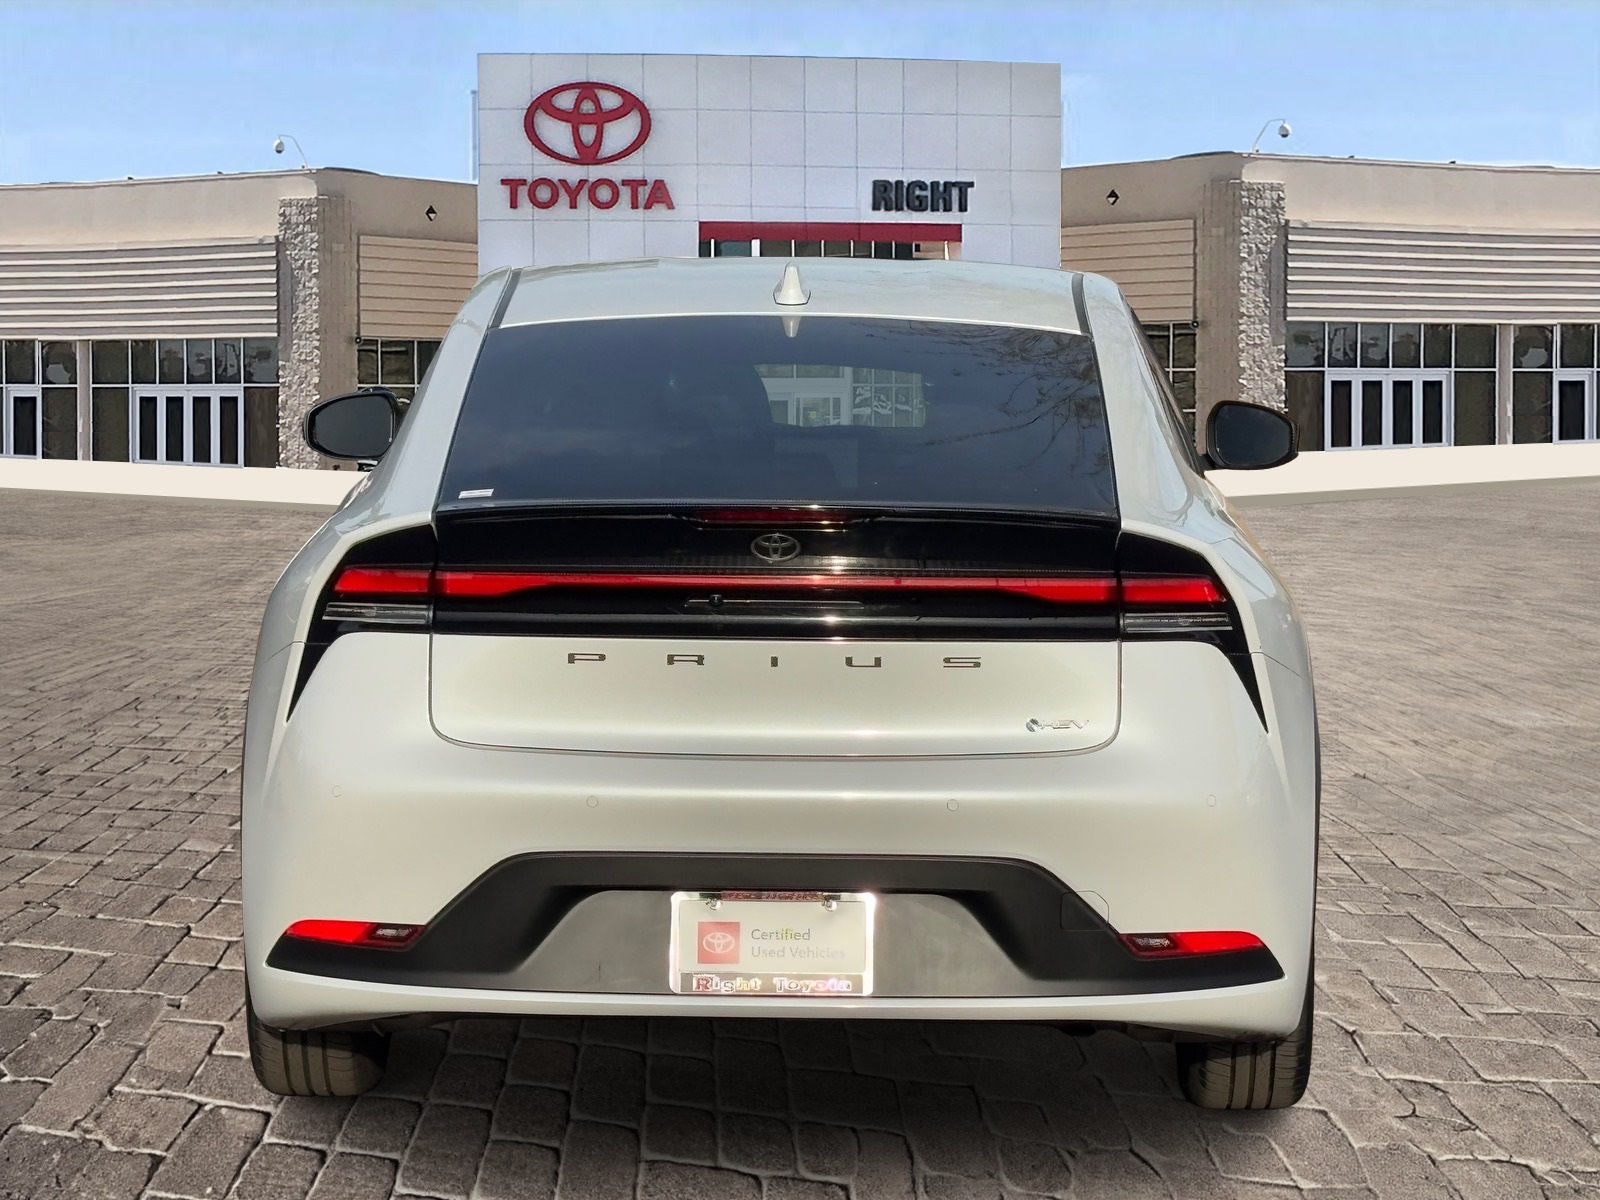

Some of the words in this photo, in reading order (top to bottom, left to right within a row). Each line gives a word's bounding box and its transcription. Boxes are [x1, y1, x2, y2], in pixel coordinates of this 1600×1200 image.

[500, 178, 675, 210] TOYOTA
[871, 179, 975, 212] RIGHT
[567, 652, 982, 669] PRIUS
[751, 928, 811, 941] Certified
[751, 946, 786, 959] Used
[790, 946, 846, 959] Vehicles
[693, 974, 762, 993] Right
[773, 976, 852, 993] Toyota
